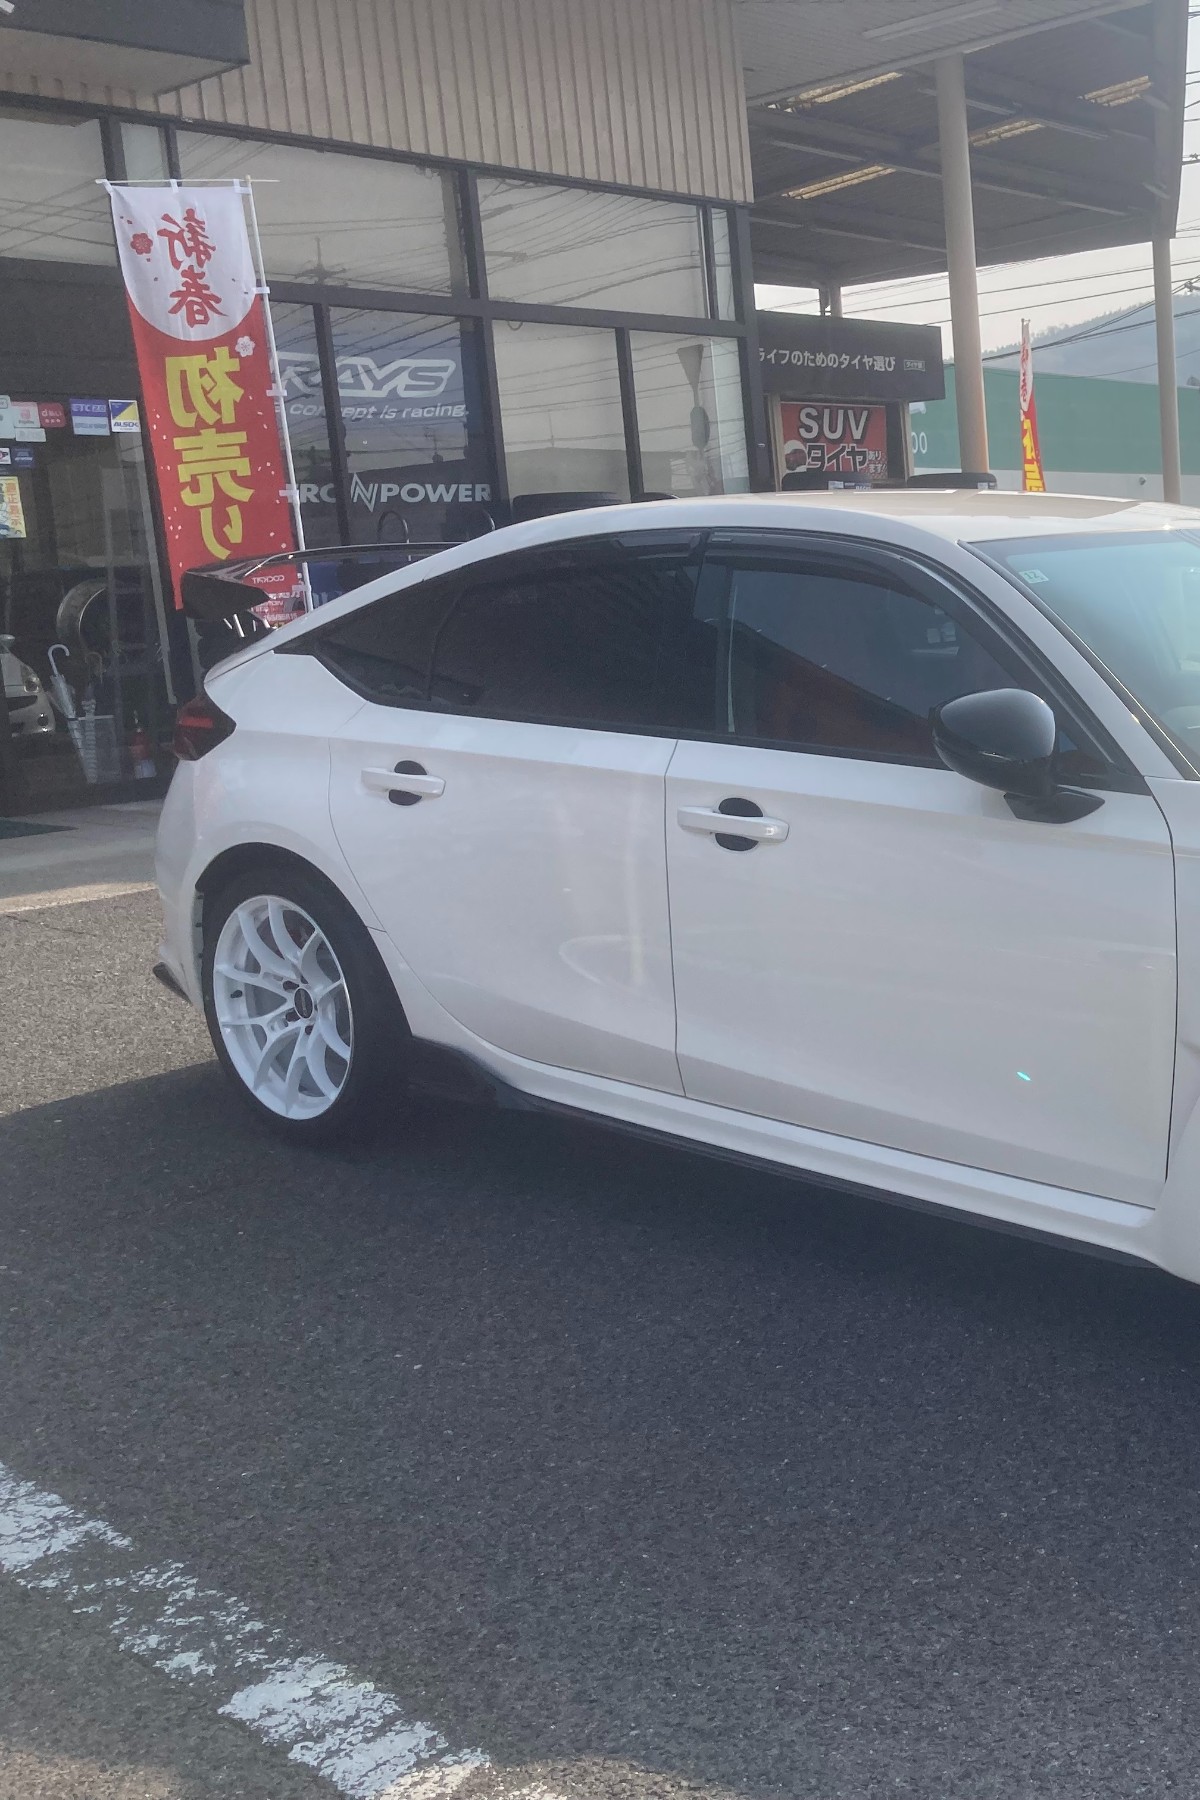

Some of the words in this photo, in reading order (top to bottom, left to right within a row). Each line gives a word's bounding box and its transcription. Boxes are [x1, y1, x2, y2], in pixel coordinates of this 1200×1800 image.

[270, 351, 456, 398] RAYS
[290, 403, 376, 420] conept
[380, 404, 398, 419] is
[798, 407, 869, 440] SUV
[806, 442, 869, 472] タイヤ
